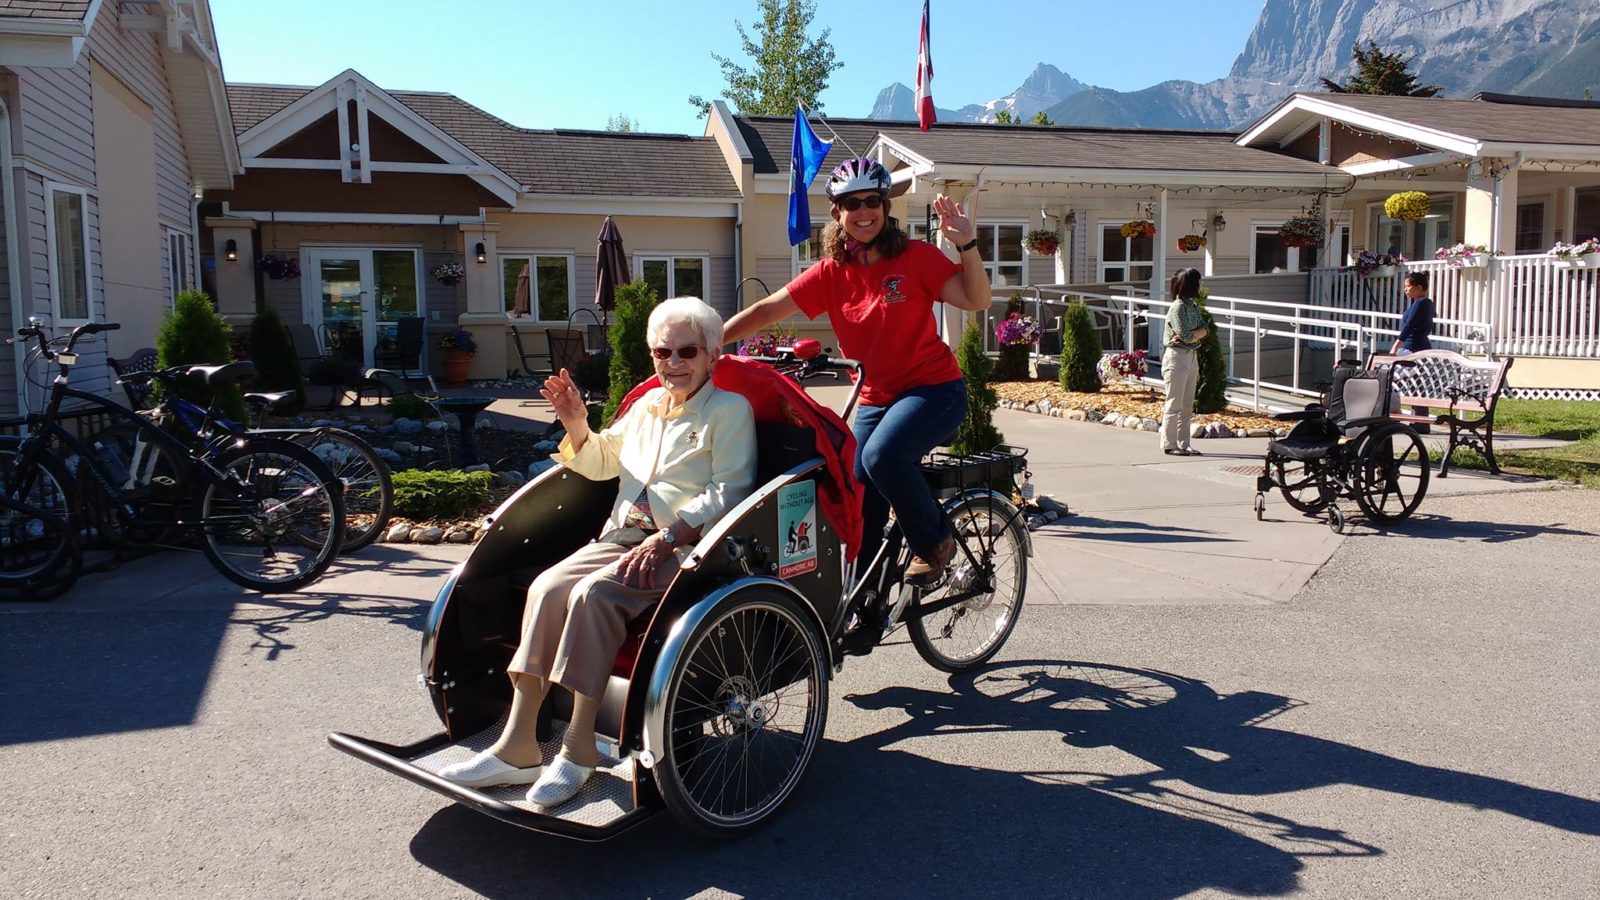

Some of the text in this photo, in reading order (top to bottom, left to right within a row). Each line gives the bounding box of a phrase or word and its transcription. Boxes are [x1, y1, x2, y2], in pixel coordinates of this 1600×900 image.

[786, 489, 807, 501] CYCLING
[780, 496, 814, 510] WITHOUT AGE
